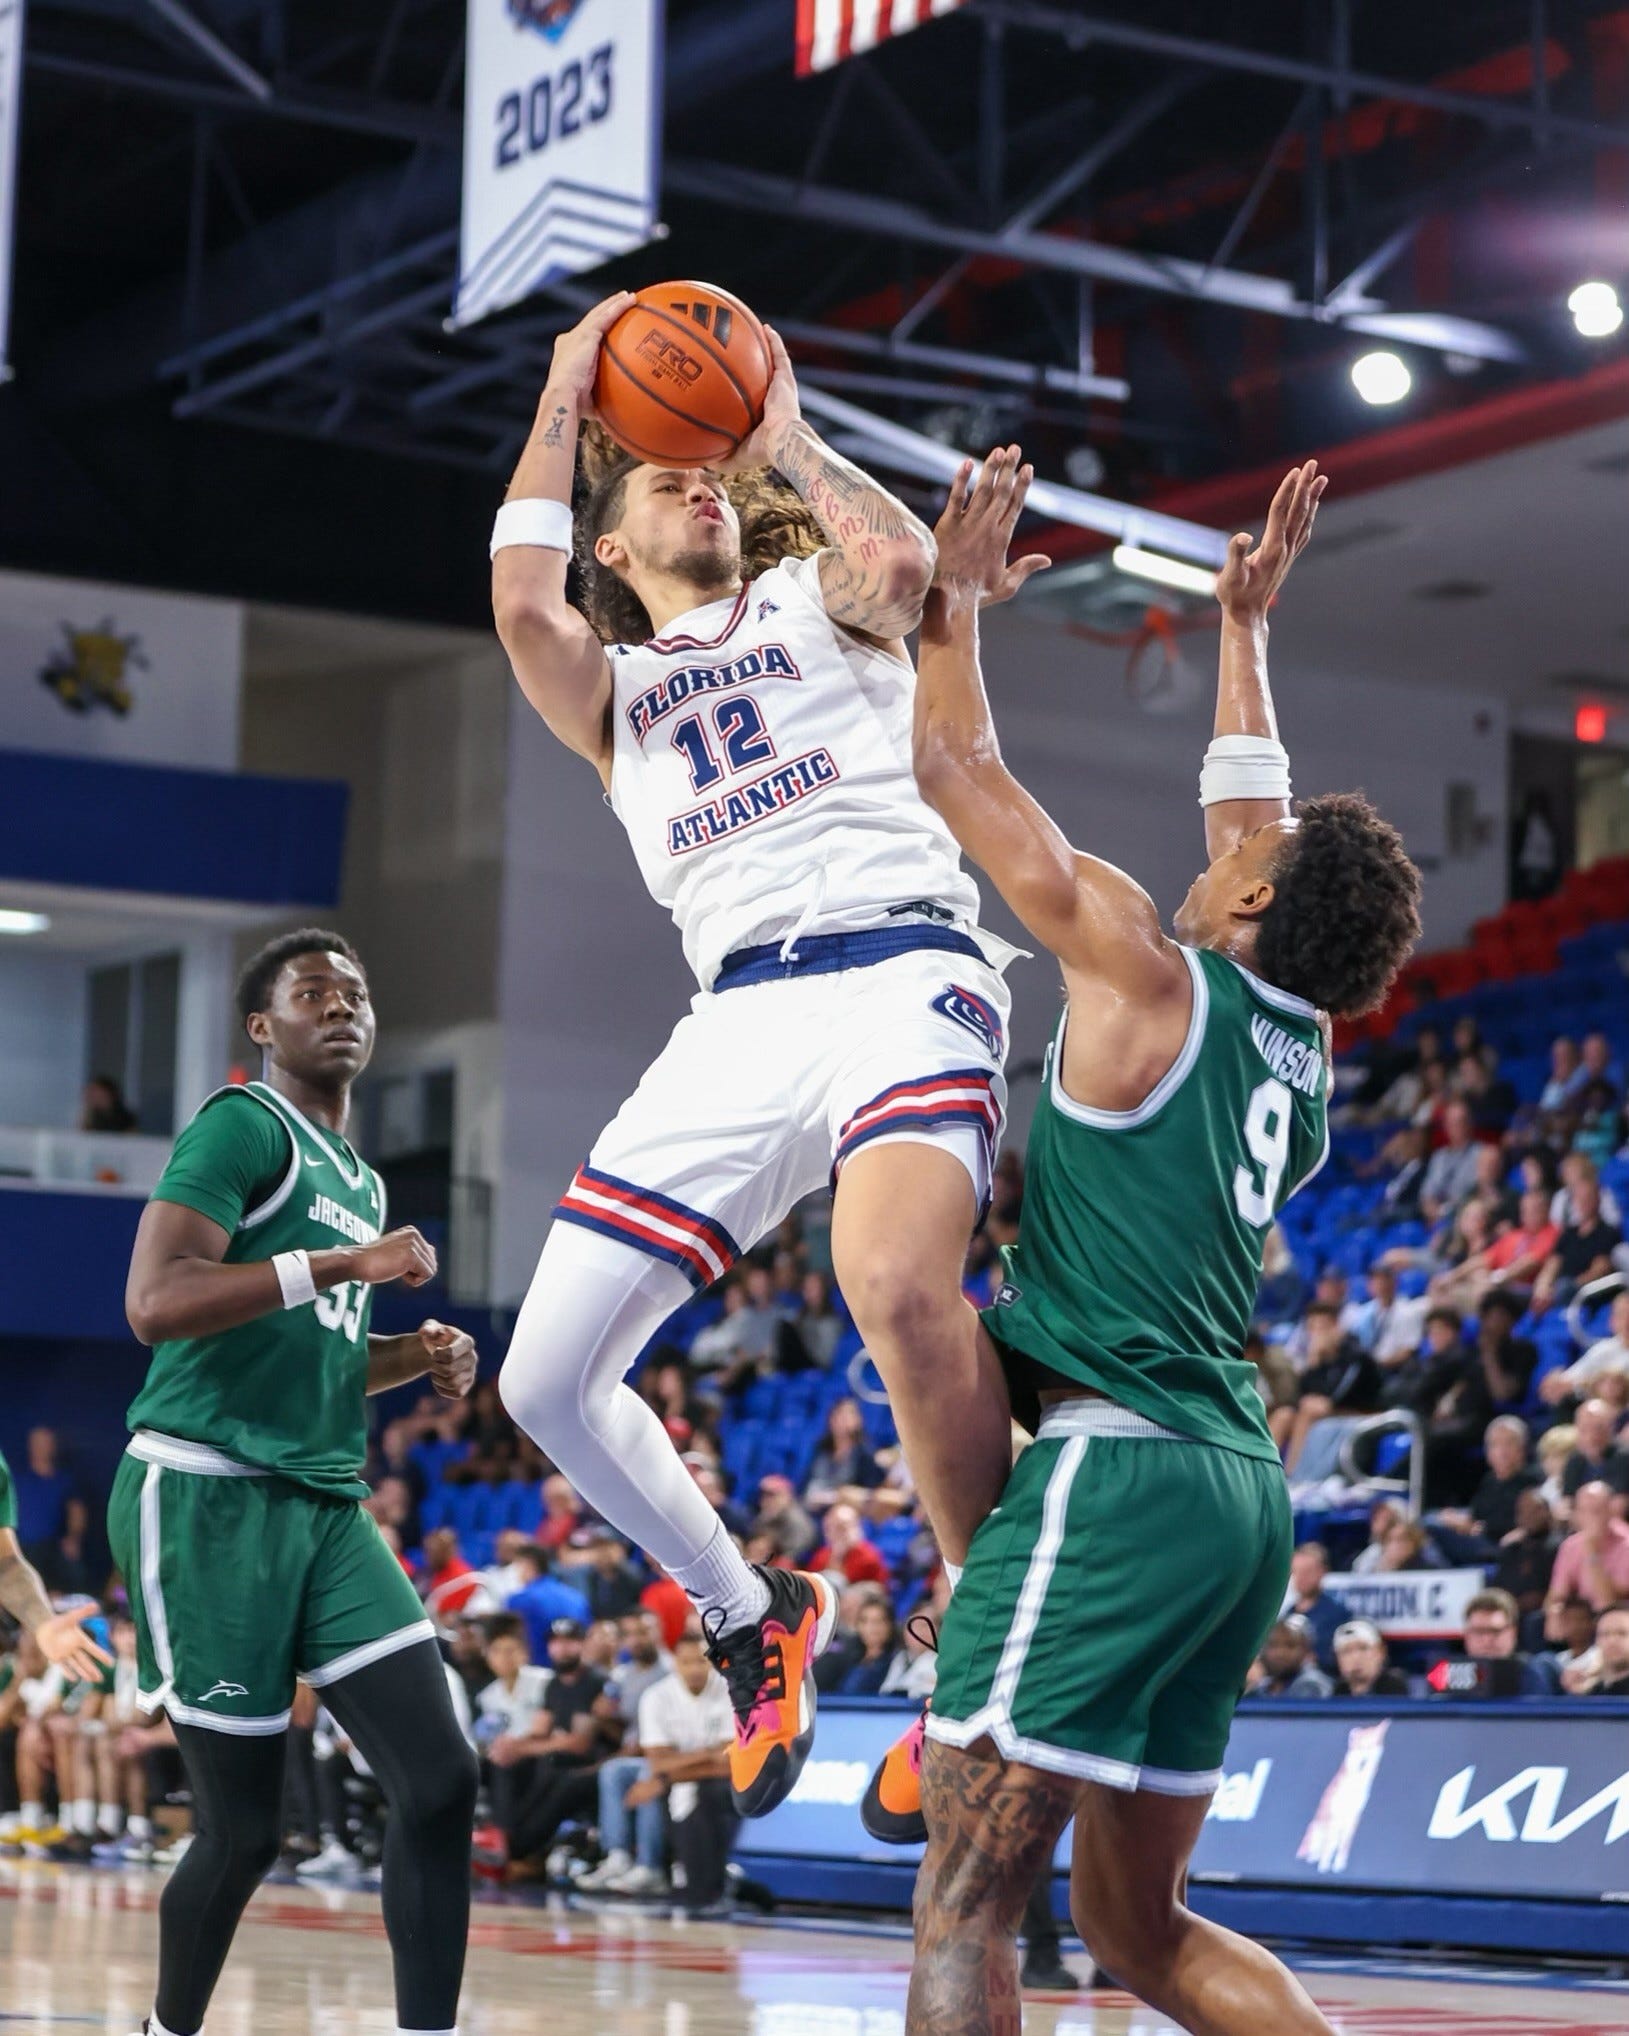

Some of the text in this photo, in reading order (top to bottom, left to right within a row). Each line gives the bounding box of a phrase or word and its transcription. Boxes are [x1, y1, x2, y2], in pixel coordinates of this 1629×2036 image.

[496, 43, 614, 170] 2023
[635, 328, 704, 382] PRO
[627, 644, 801, 743] FLORIDA
[670, 694, 777, 796] 12
[667, 748, 840, 856] ATLANTIC
[1233, 1077, 1292, 1229] 9
